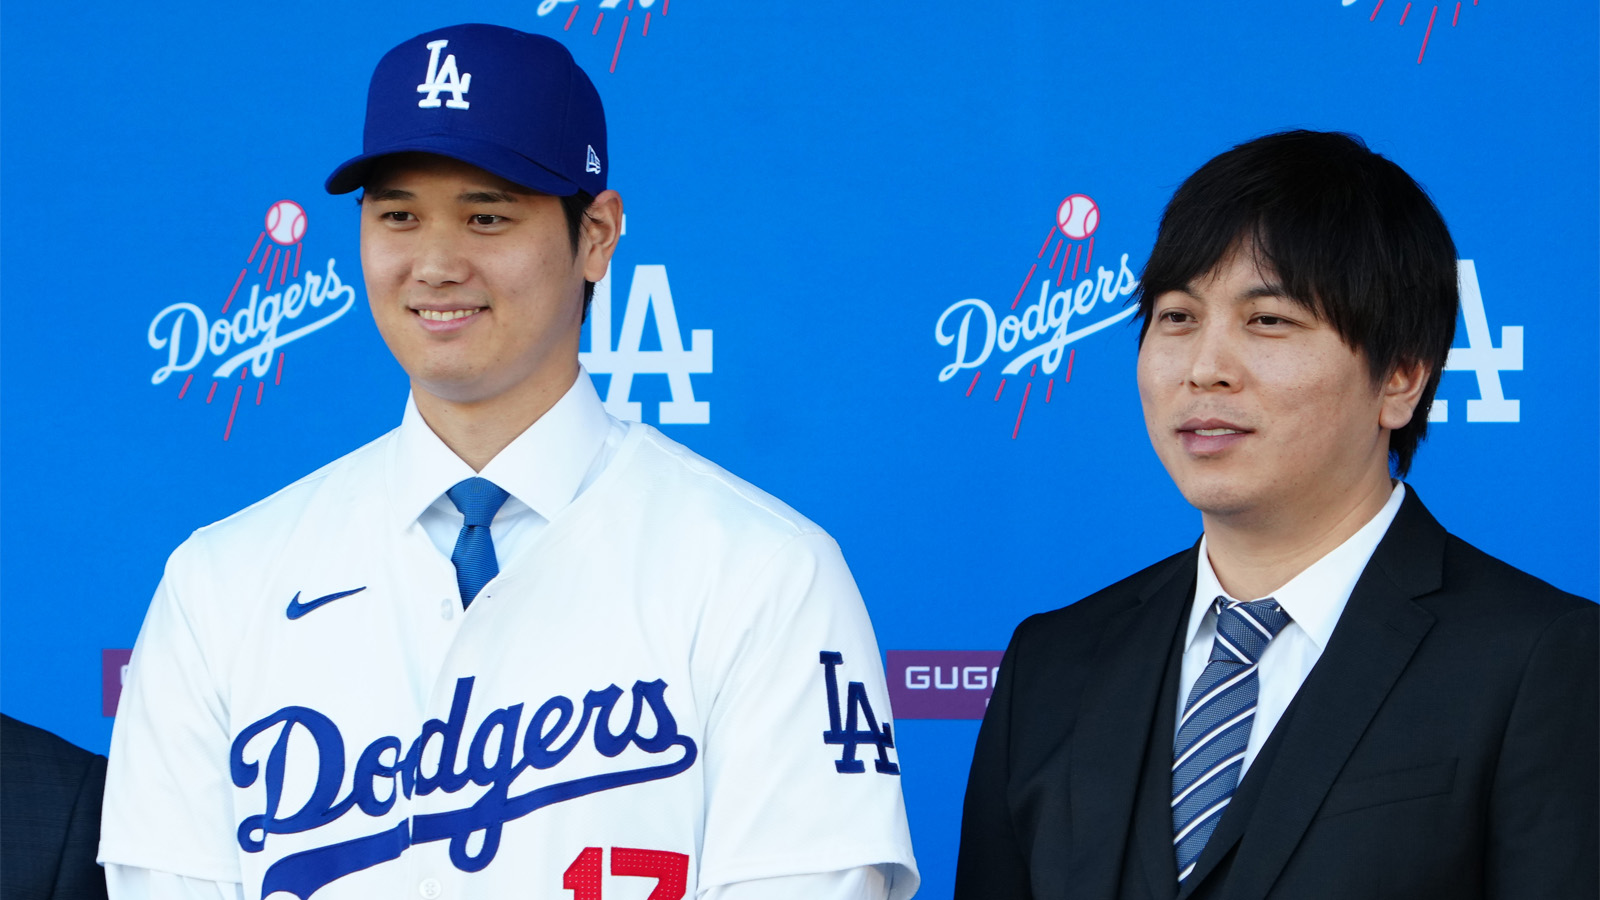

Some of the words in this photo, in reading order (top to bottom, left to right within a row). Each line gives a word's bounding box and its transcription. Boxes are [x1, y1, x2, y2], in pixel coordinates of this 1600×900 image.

[417, 39, 472, 110] LA
[148, 258, 355, 385] Dodgers
[935, 253, 1142, 382] Dodgers
[819, 651, 901, 775] LA
[905, 666, 1000, 689] GUG
[230, 676, 698, 900] Dodgers
